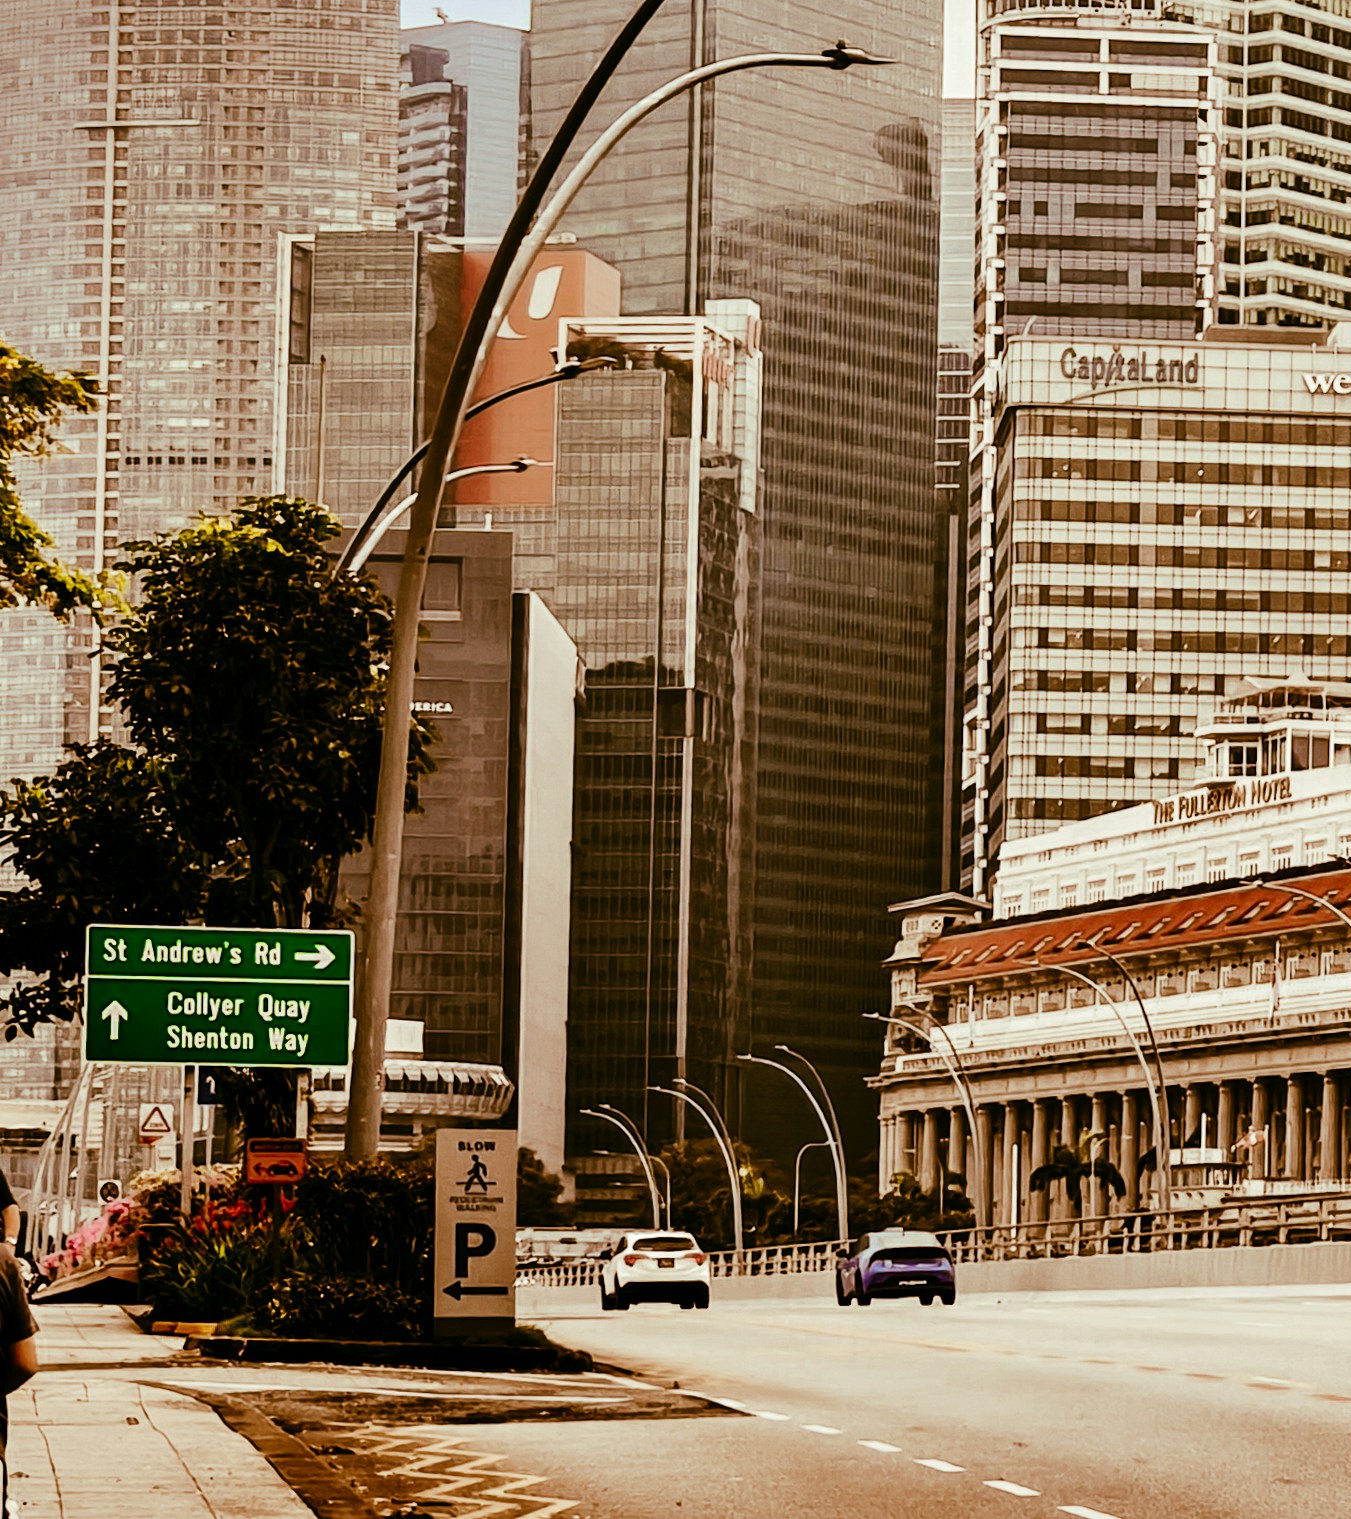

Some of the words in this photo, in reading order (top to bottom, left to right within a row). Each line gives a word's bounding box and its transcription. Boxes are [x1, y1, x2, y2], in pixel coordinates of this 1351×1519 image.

[1060, 344, 1199, 391] CapitaLand
[1250, 777, 1292, 806] HOTEL
[103, 938, 127, 962] St
[141, 939, 242, 965] Andrew's
[254, 942, 281, 966] Rd
[167, 991, 244, 1021] Collyer
[258, 993, 311, 1023] Quay
[166, 1024, 254, 1050] Shenton
[268, 1026, 309, 1057] Way
[455, 1222, 497, 1279] P
